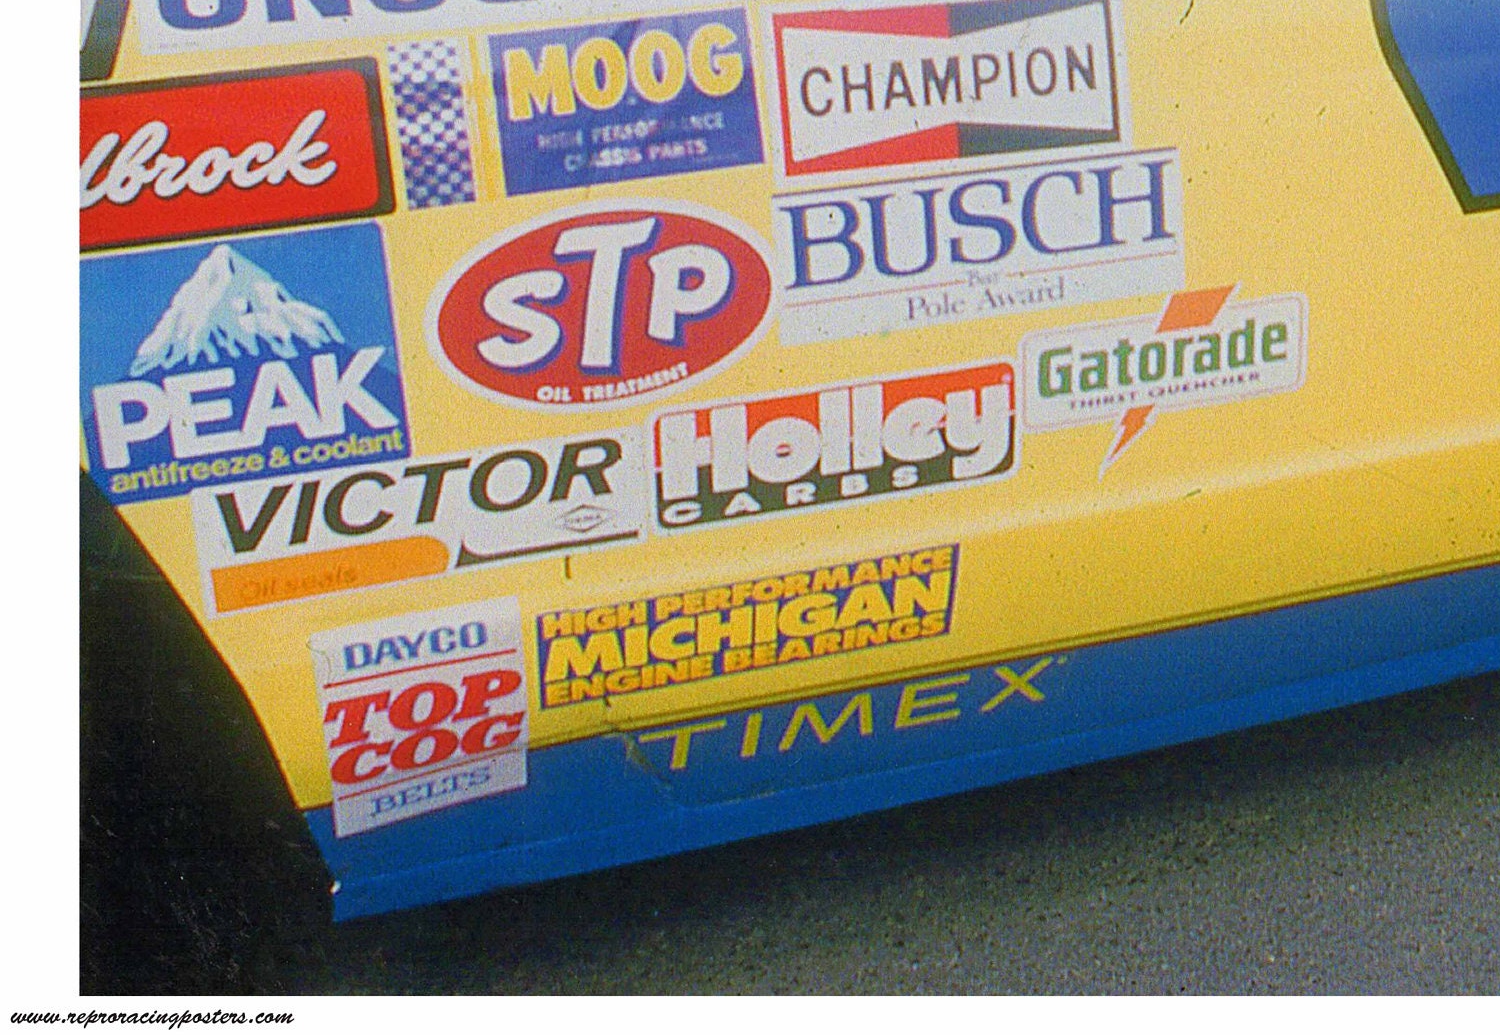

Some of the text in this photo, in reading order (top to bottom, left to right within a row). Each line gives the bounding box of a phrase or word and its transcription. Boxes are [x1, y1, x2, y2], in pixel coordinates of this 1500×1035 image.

[504, 22, 744, 123] MOOG
[799, 41, 1098, 118] CHAMPION
[592, 112, 726, 145] PERFONCE
[779, 159, 1177, 291] BUSCH
[477, 216, 735, 374] STP
[907, 274, 1065, 320] Pole Award
[536, 361, 688, 402] OIL TREATMENT
[1037, 319, 1288, 398] Gatorade
[93, 345, 400, 469] PEAK
[660, 378, 1016, 501] Holley
[111, 429, 404, 493] antifreeze & coolant
[215, 435, 622, 554] VICTOR
[663, 464, 919, 526] CARBS
[542, 546, 953, 639] HIGH PERFORMANCE
[546, 570, 951, 682] MICHIGAN
[343, 621, 487, 670] DAYCO
[544, 611, 946, 707] ENGINE BEARINGS
[323, 670, 522, 749] TOP
[331, 711, 526, 784] COG
[638, 656, 1054, 770] TIMEX
[371, 766, 491, 818] BELTS
